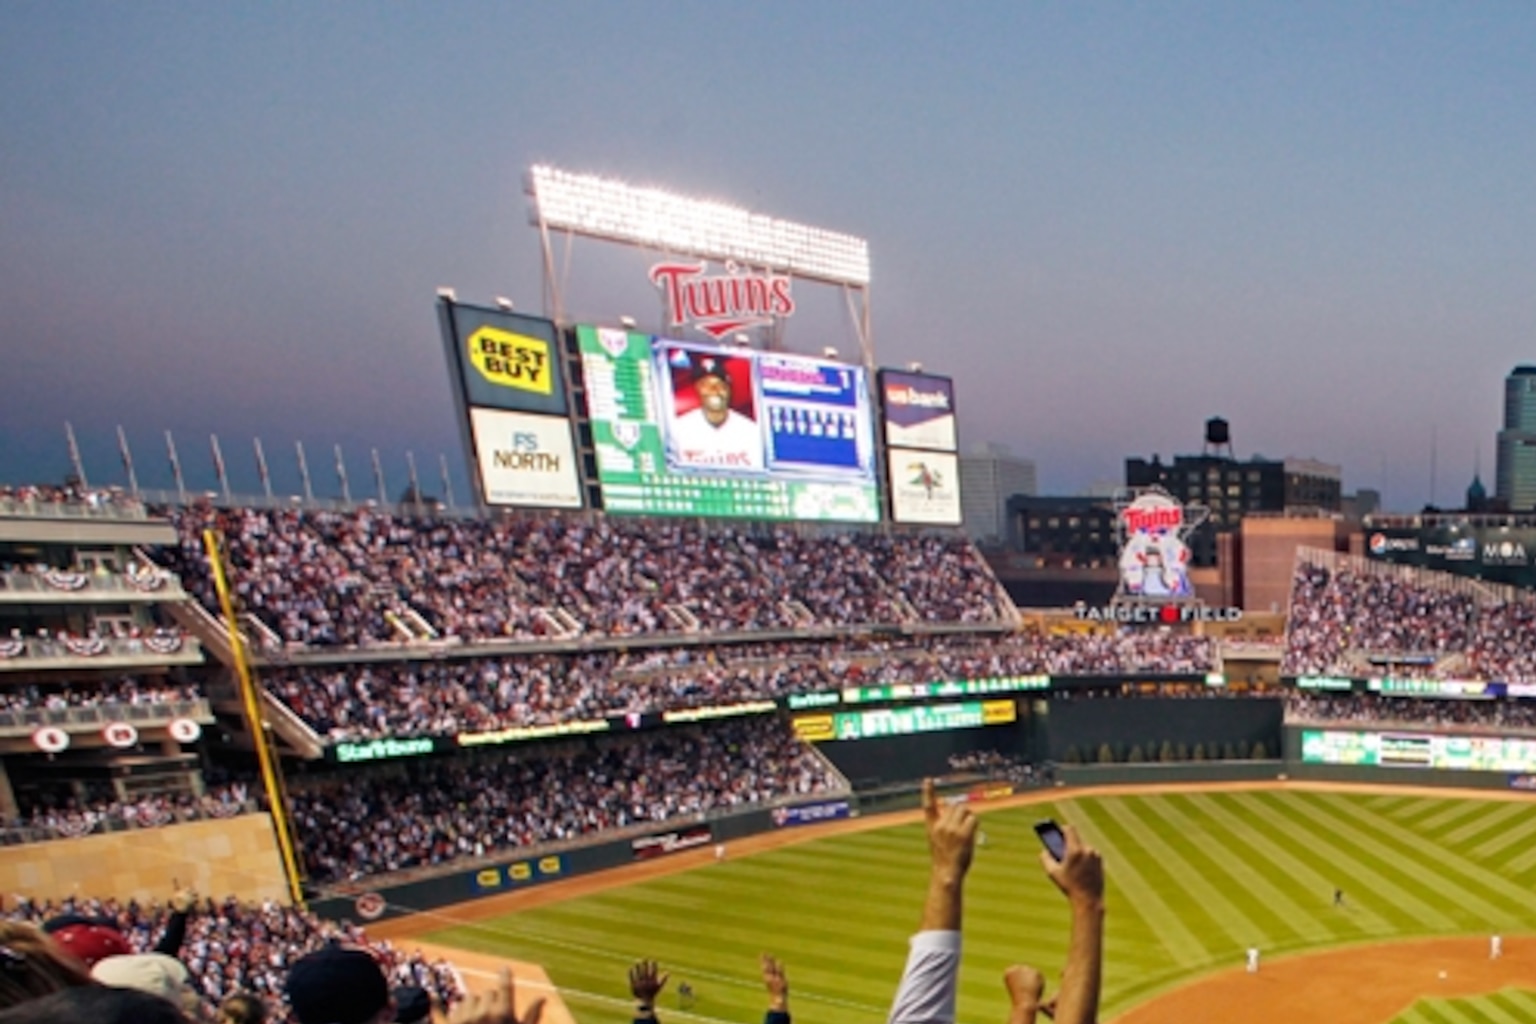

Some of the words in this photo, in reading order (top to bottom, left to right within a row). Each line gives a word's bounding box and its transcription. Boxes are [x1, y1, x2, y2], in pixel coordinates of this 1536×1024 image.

[650, 263, 794, 324] Twins
[480, 337, 544, 366] BEST
[484, 357, 540, 382] BUY
[494, 450, 560, 471] NORTH
[1122, 507, 1183, 533] Twins
[1075, 606, 1161, 622] TARGET
[1180, 607, 1243, 622] FIELD
